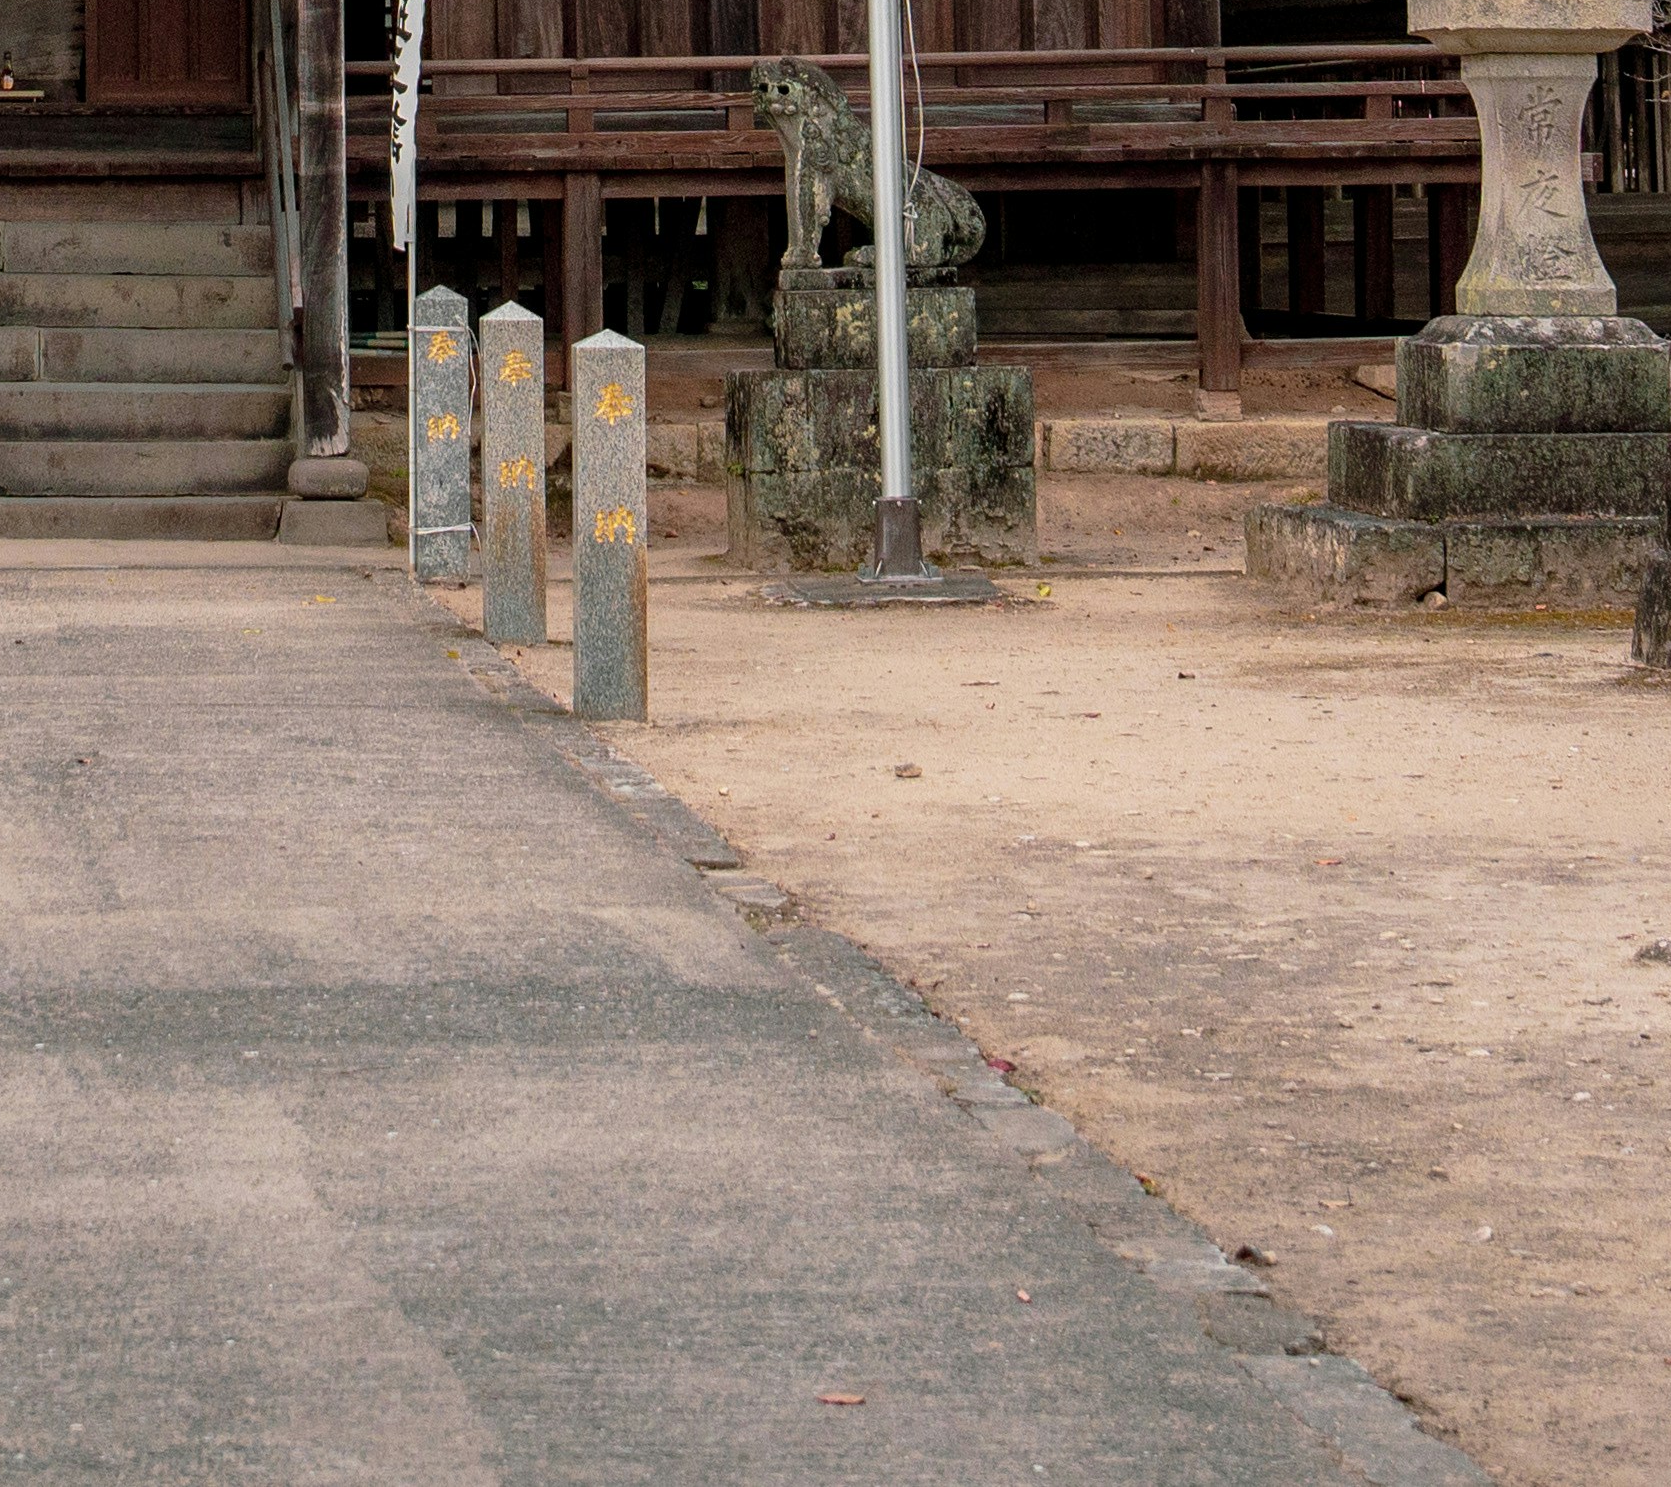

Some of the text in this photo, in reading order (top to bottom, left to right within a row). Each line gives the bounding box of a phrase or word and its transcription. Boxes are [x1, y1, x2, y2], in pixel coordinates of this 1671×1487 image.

[1516, 84, 1577, 282] 常夜燈
[427, 330, 461, 442] 奉納
[498, 349, 536, 490] 奉納
[593, 382, 637, 544] 奉納
